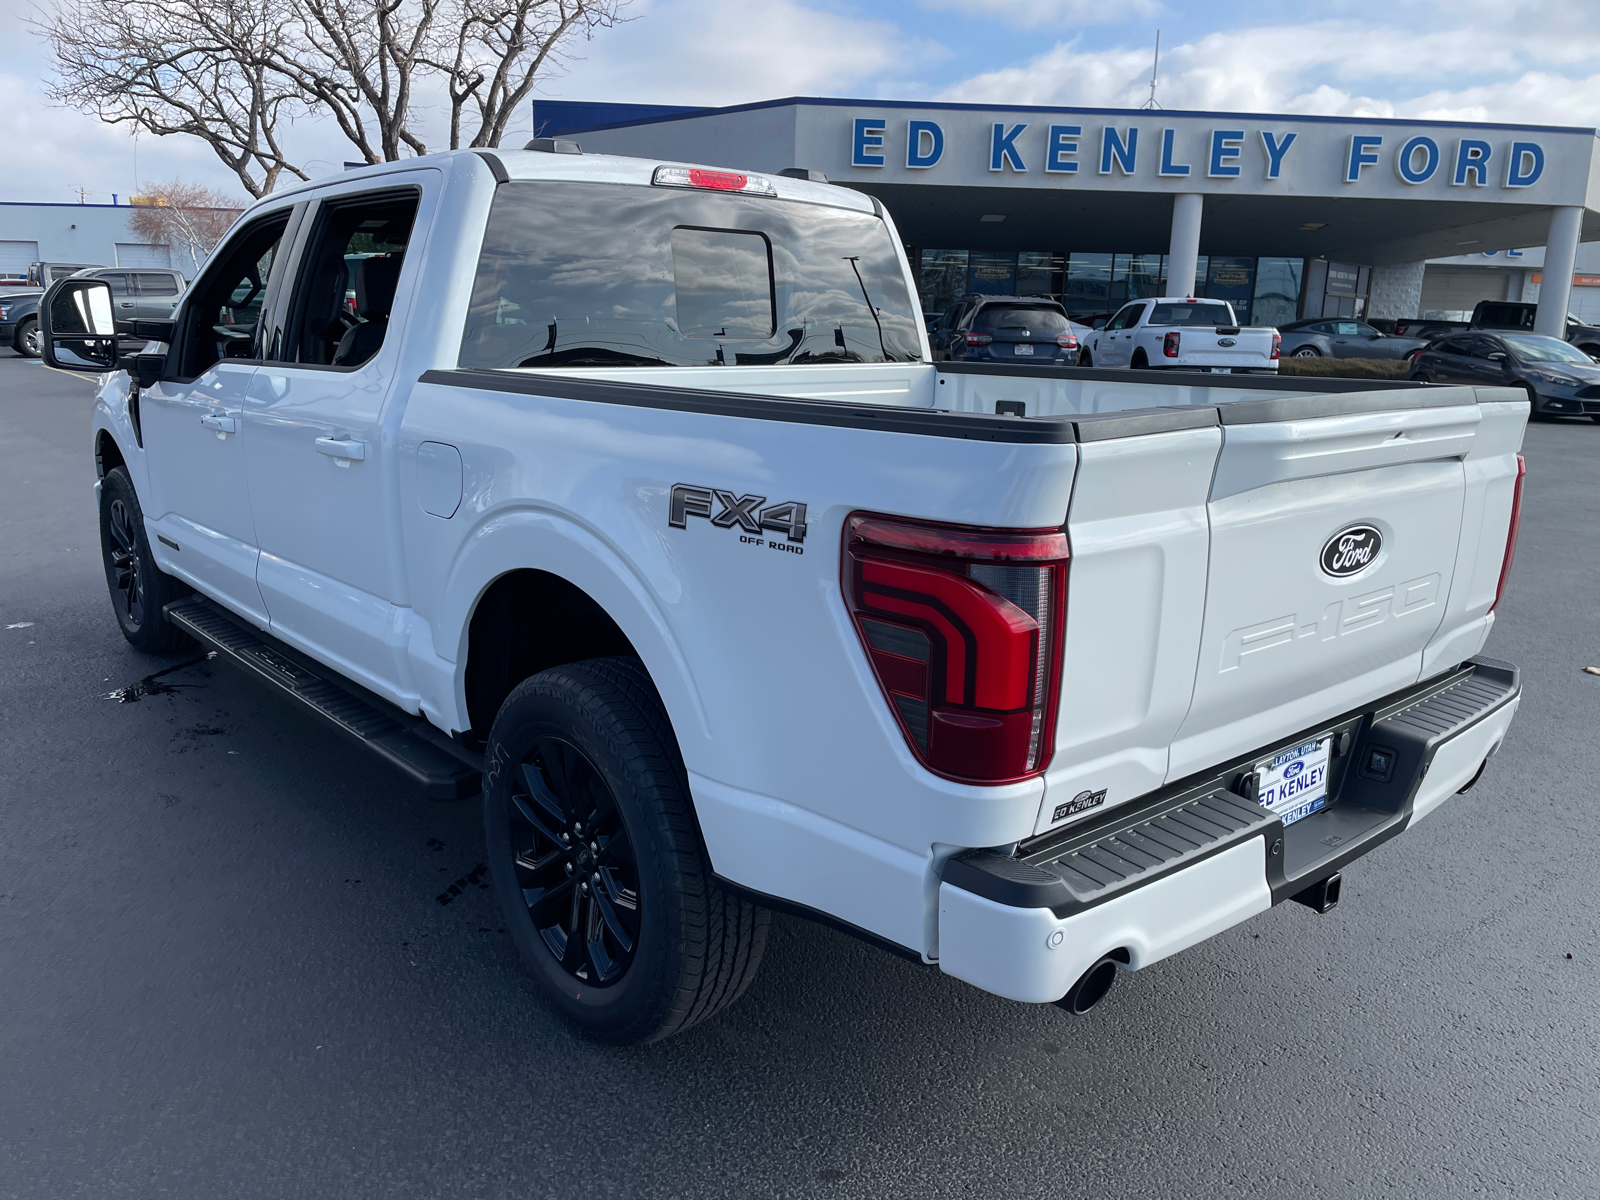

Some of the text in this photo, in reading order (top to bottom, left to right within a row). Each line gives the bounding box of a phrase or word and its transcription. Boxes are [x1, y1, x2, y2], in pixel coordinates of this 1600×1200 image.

[851, 117, 1546, 188] ED KENLEY FORD
[669, 483, 807, 543] FX4
[740, 535, 803, 555] OFF ROAD
[1332, 533, 1374, 570] Ford
[1218, 571, 1441, 674] F-150
[1301, 741, 1317, 755] UTAH
[1279, 765, 1326, 801] KENLEY
[1054, 807, 1067, 820] ED
[1069, 792, 1106, 814] KENLEY
[1282, 802, 1312, 826] KENLEY
